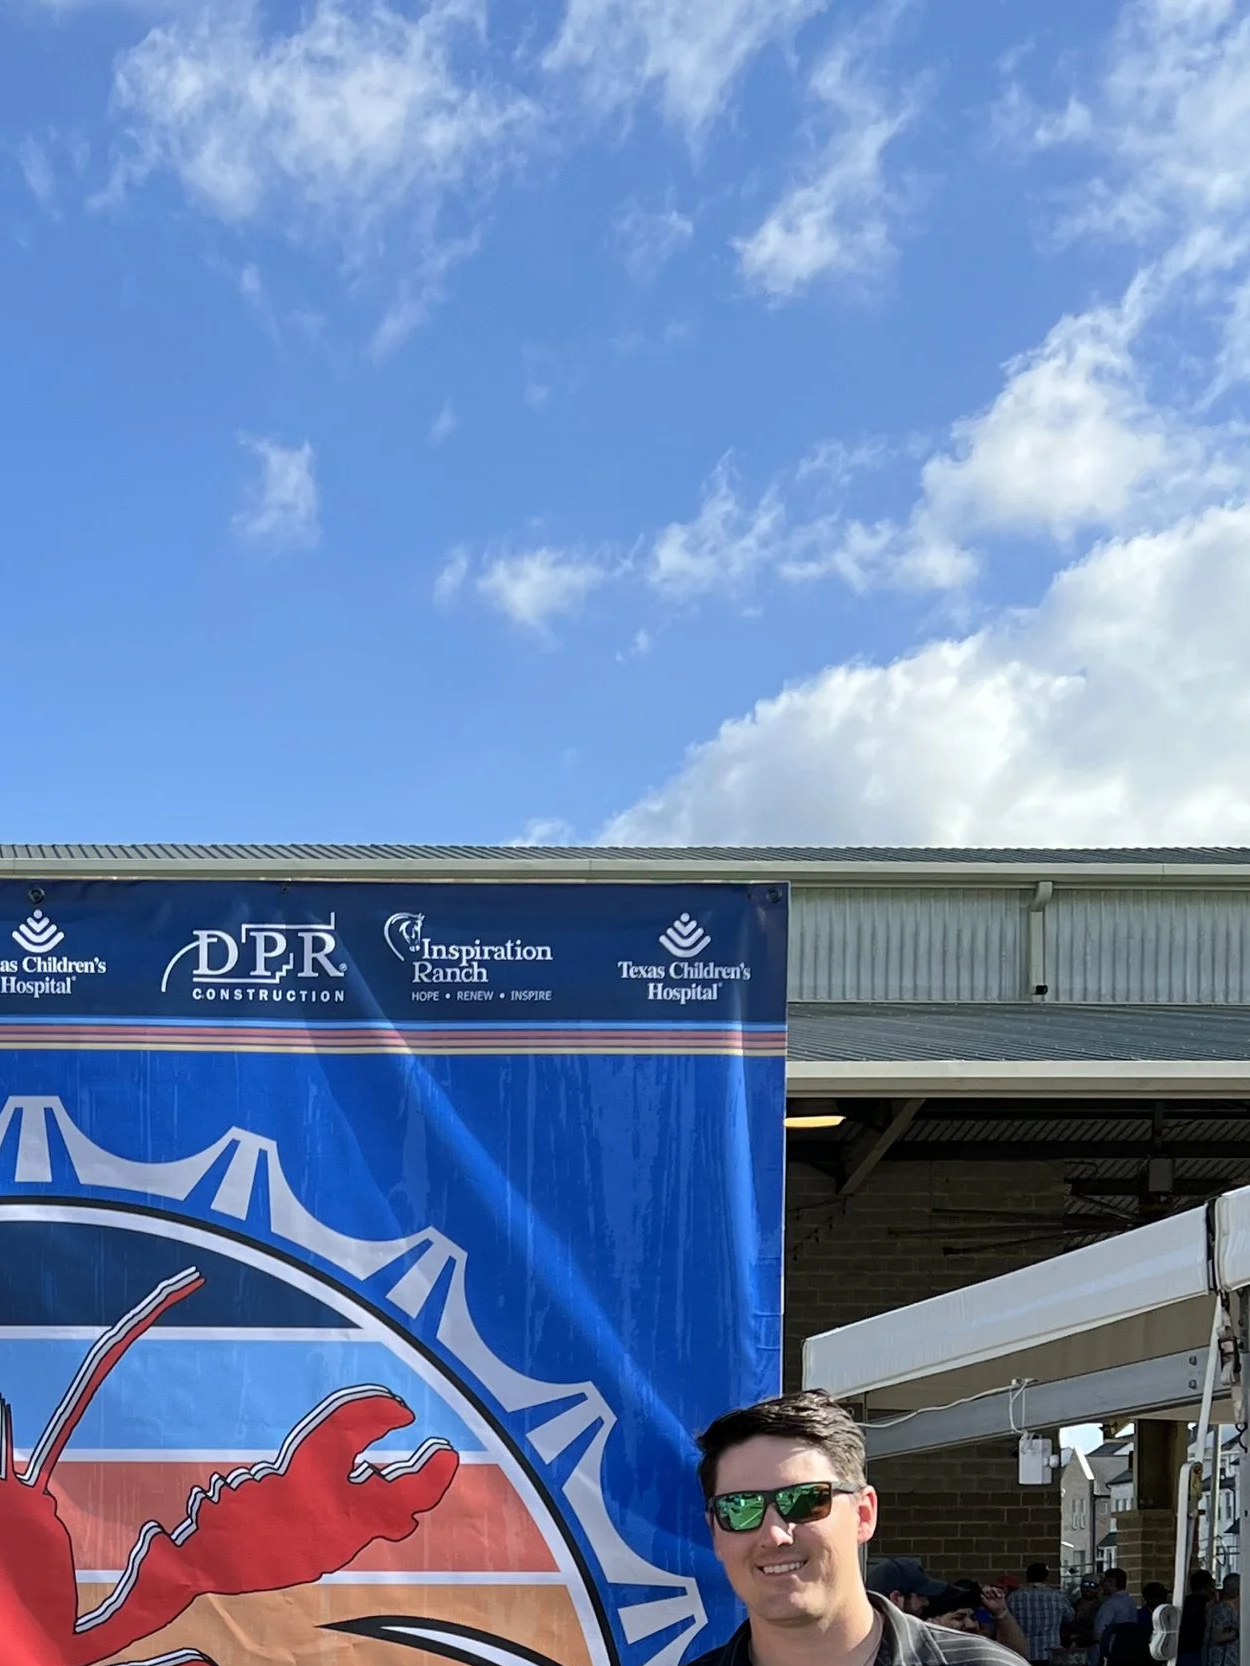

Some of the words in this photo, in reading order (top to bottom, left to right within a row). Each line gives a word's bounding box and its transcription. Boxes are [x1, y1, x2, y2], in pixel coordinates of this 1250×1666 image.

[192, 930, 345, 977] DPR
[421, 938, 554, 967] Inspiration
[21, 956, 107, 974] Children's
[412, 961, 489, 983] Ranch
[617, 960, 666, 979] Texas
[668, 961, 751, 981] Children's
[0, 976, 73, 999] Hospital
[192, 987, 345, 1002] CONSTRUCTION
[411, 990, 440, 1001] HOPE
[456, 990, 495, 1001] RENEW
[510, 990, 552, 1001] INSPIRE
[647, 982, 719, 1005] Hospital
